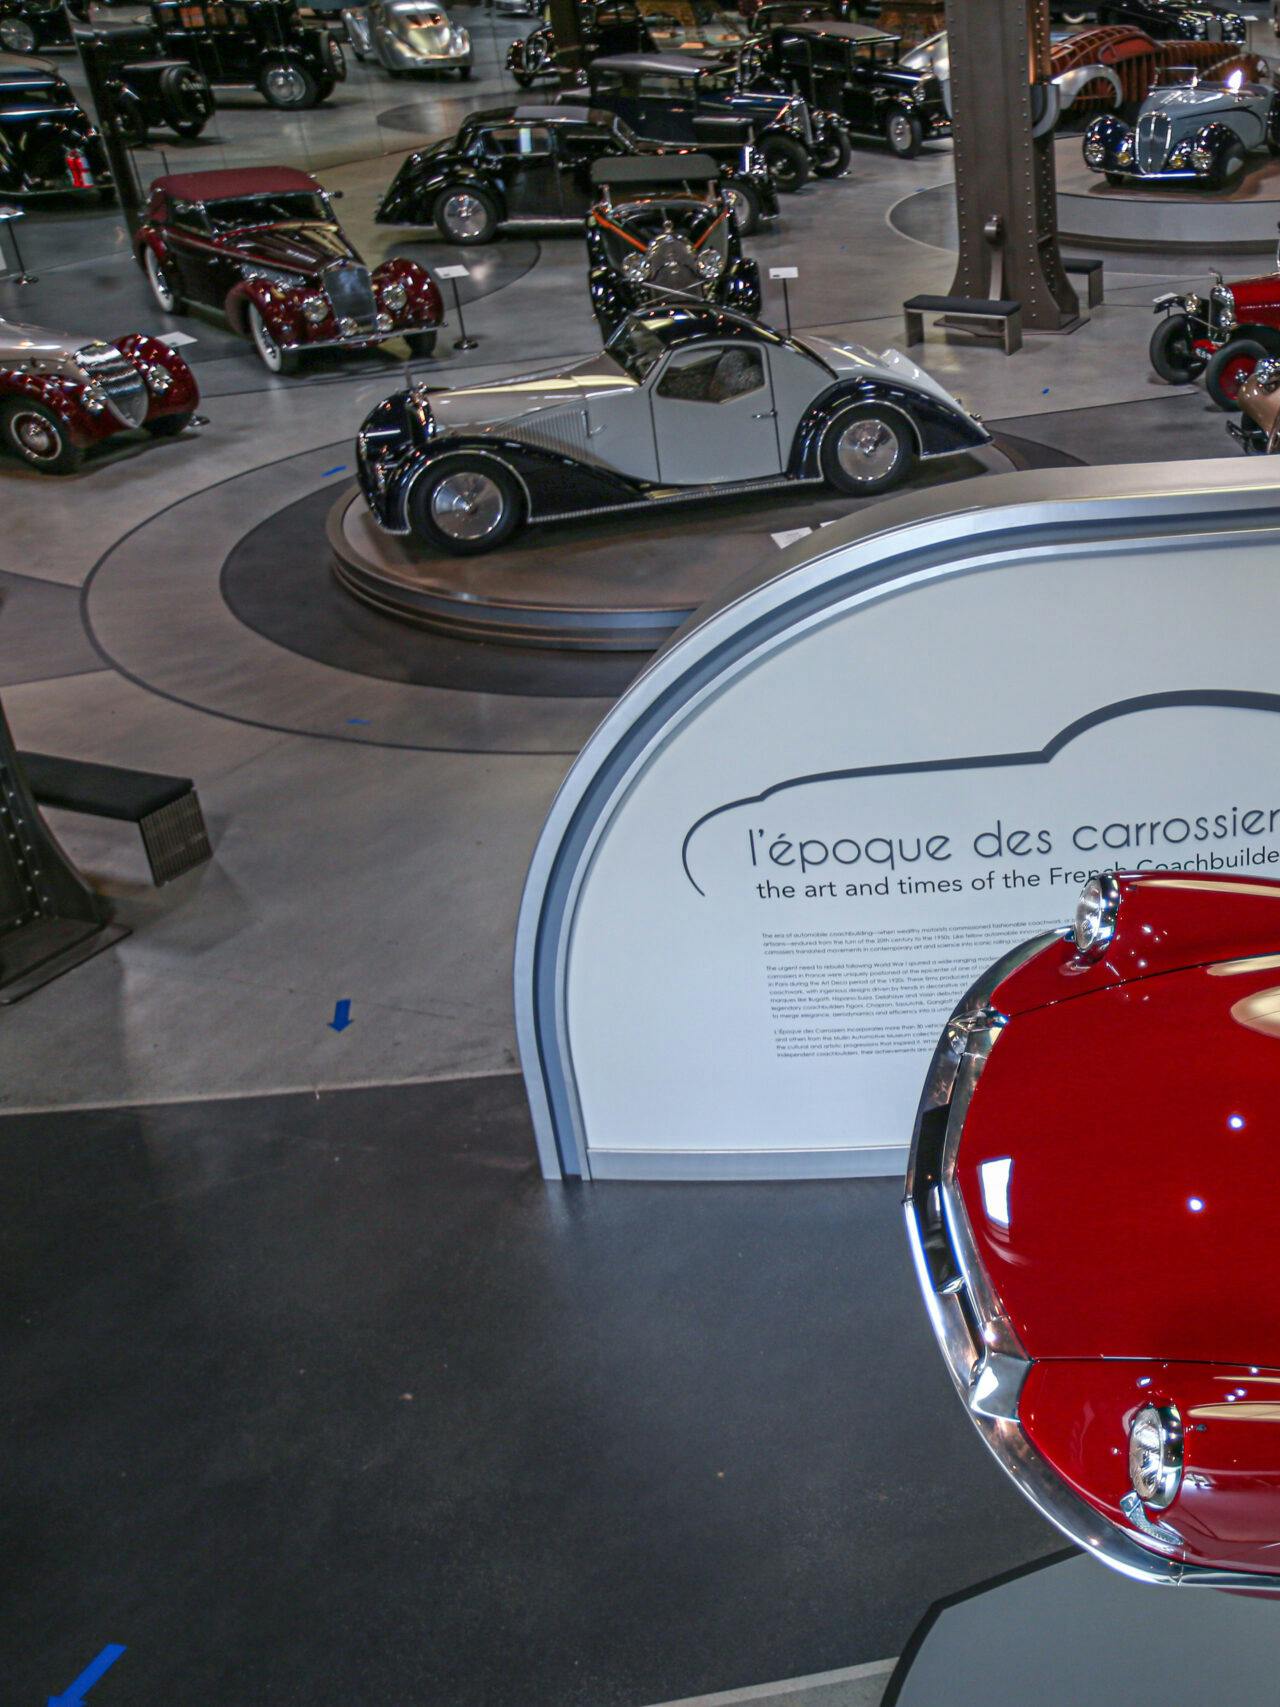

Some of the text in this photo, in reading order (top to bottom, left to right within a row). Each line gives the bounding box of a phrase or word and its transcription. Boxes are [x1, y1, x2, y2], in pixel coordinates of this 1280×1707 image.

[748, 828, 952, 874] l'époque
[972, 818, 1053, 857] des
[756, 879, 796, 899] the
[804, 881, 838, 898] art
[845, 876, 890, 896] and
[897, 876, 963, 895] times
[970, 870, 996, 891] of
[1002, 868, 1041, 888] the
